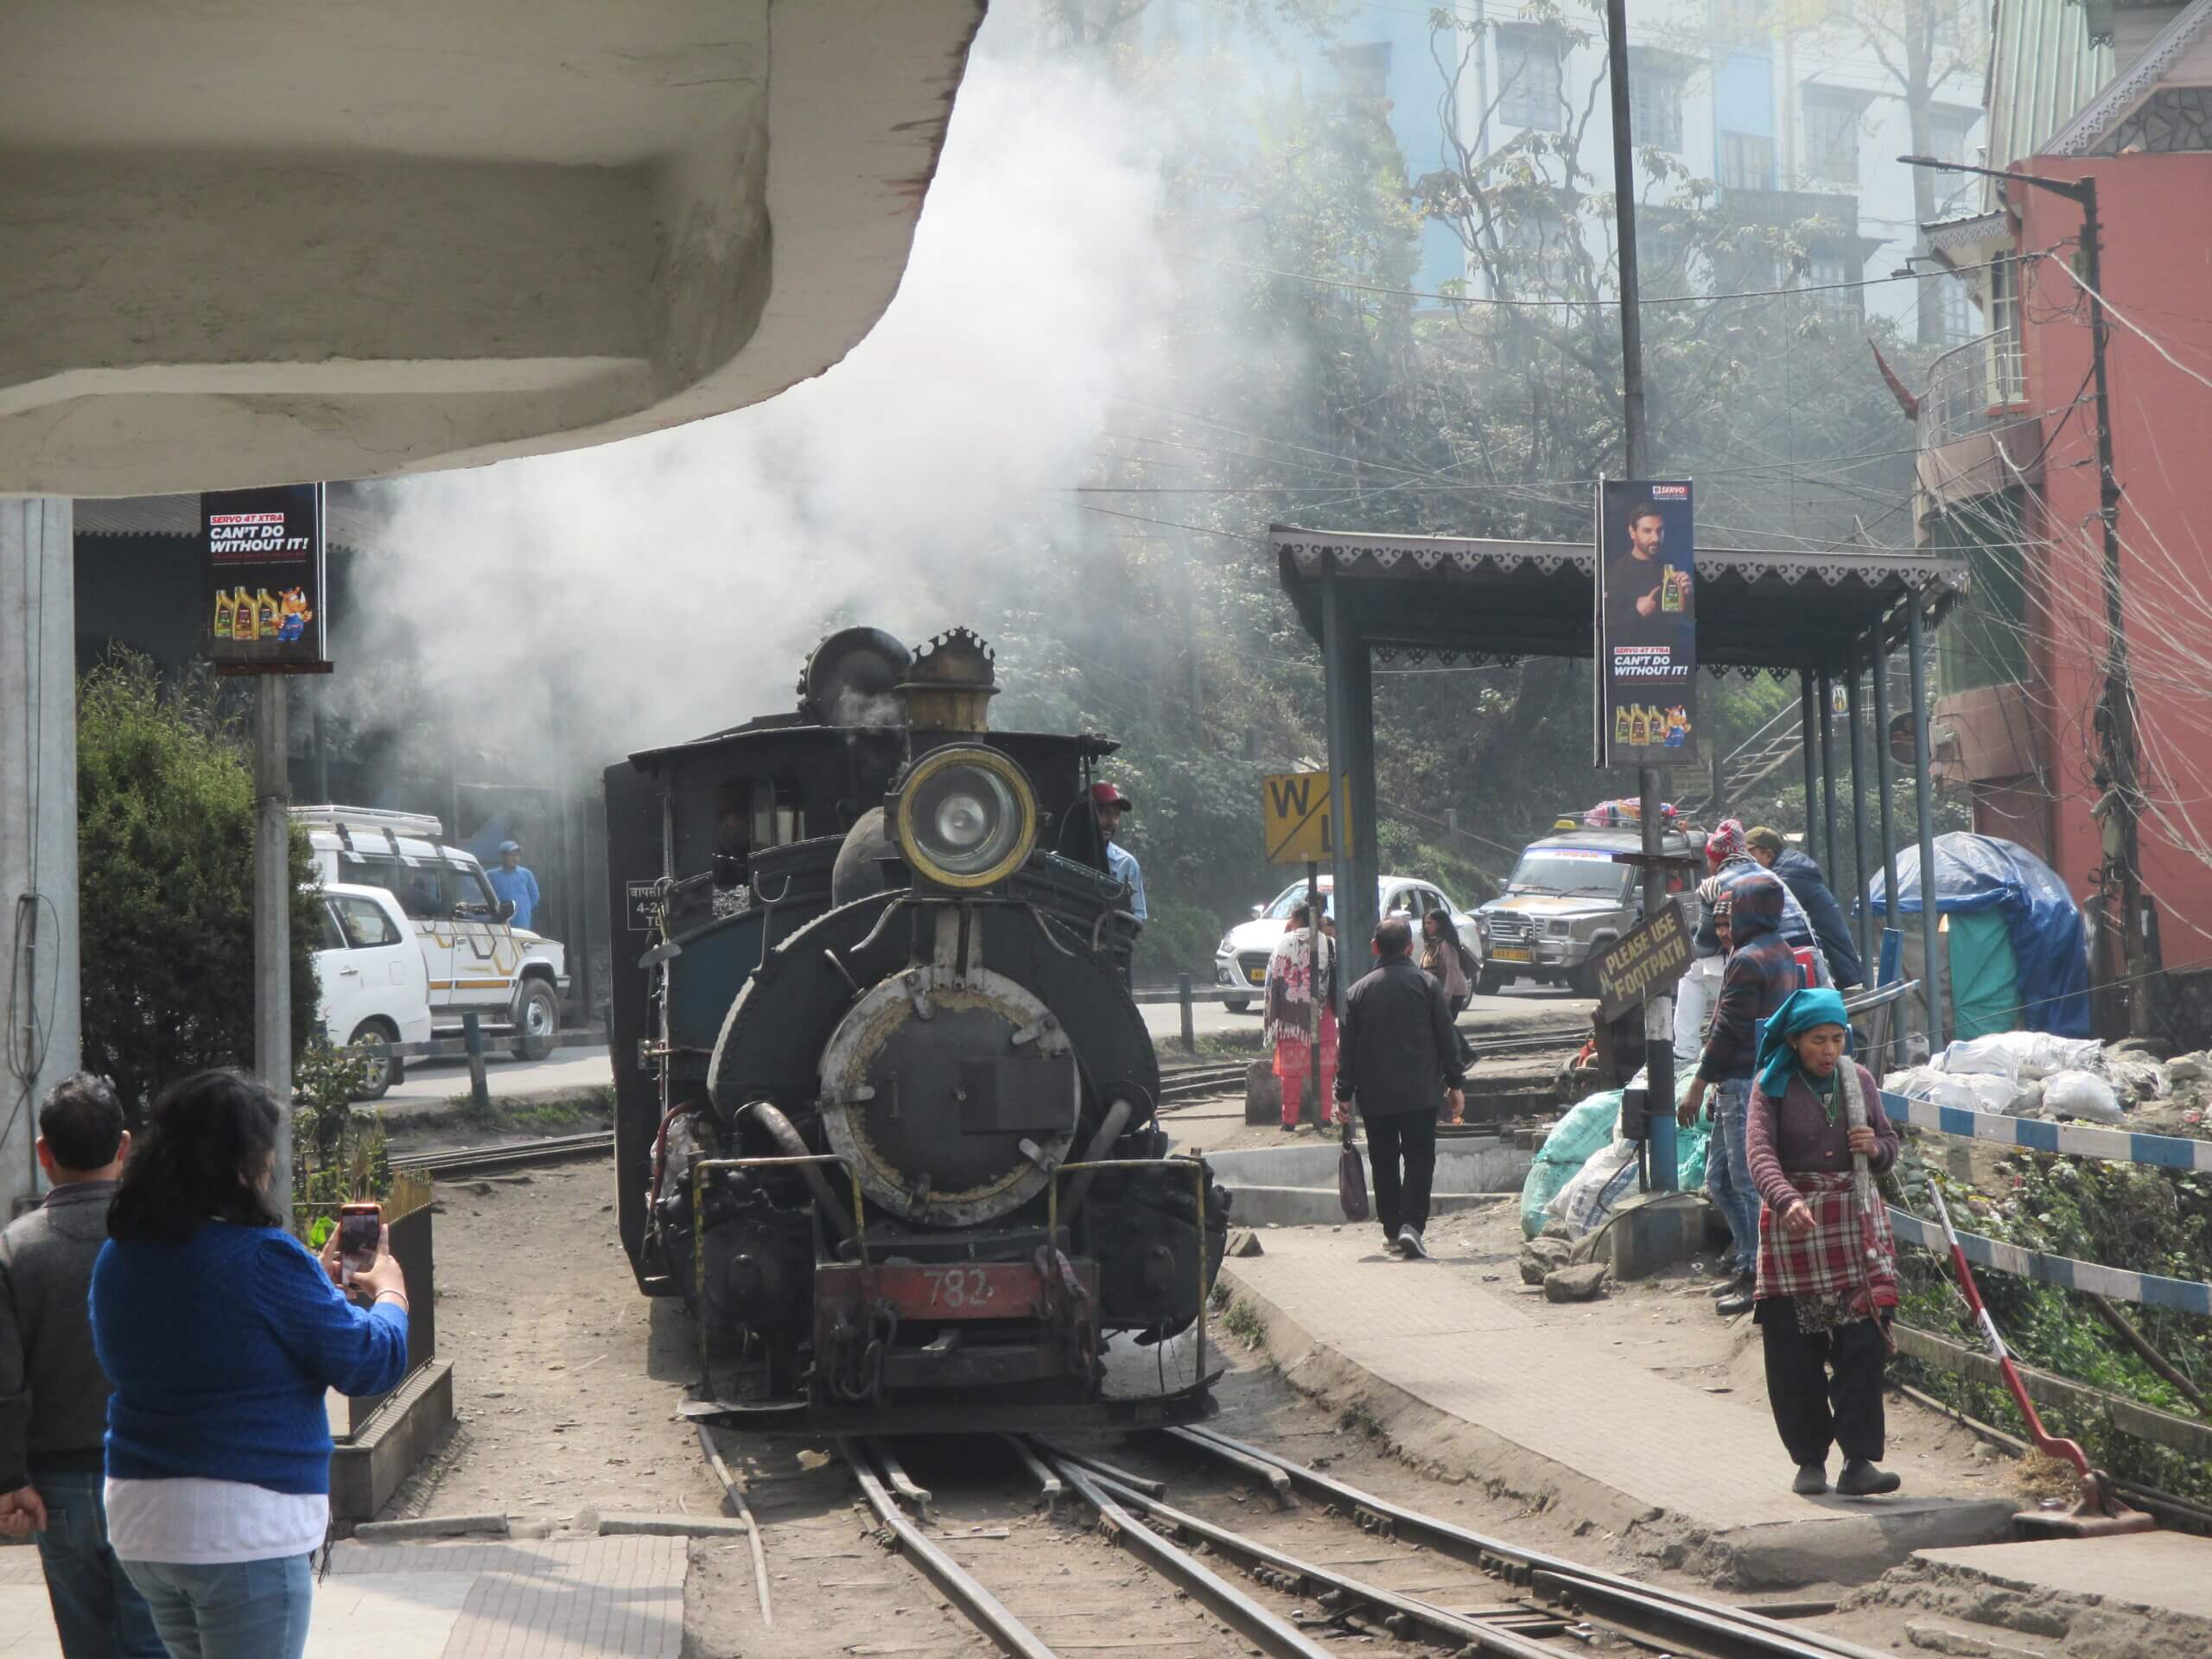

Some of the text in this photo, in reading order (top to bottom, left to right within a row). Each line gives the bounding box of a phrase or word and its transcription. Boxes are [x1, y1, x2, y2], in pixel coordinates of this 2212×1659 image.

[258, 513, 283, 522] XTRA
[210, 524, 284, 539] CAN'T DO
[210, 537, 309, 553] WITHOUT IT!
[1614, 656, 1670, 665] CAN'T DO
[1614, 665, 1688, 676] WITHOUT IT!
[1269, 779, 1310, 817] W
[1605, 912, 1677, 976] PLEASE USE
[1613, 936, 1686, 1001] FOOTPATH
[924, 1269, 988, 1309] 782
